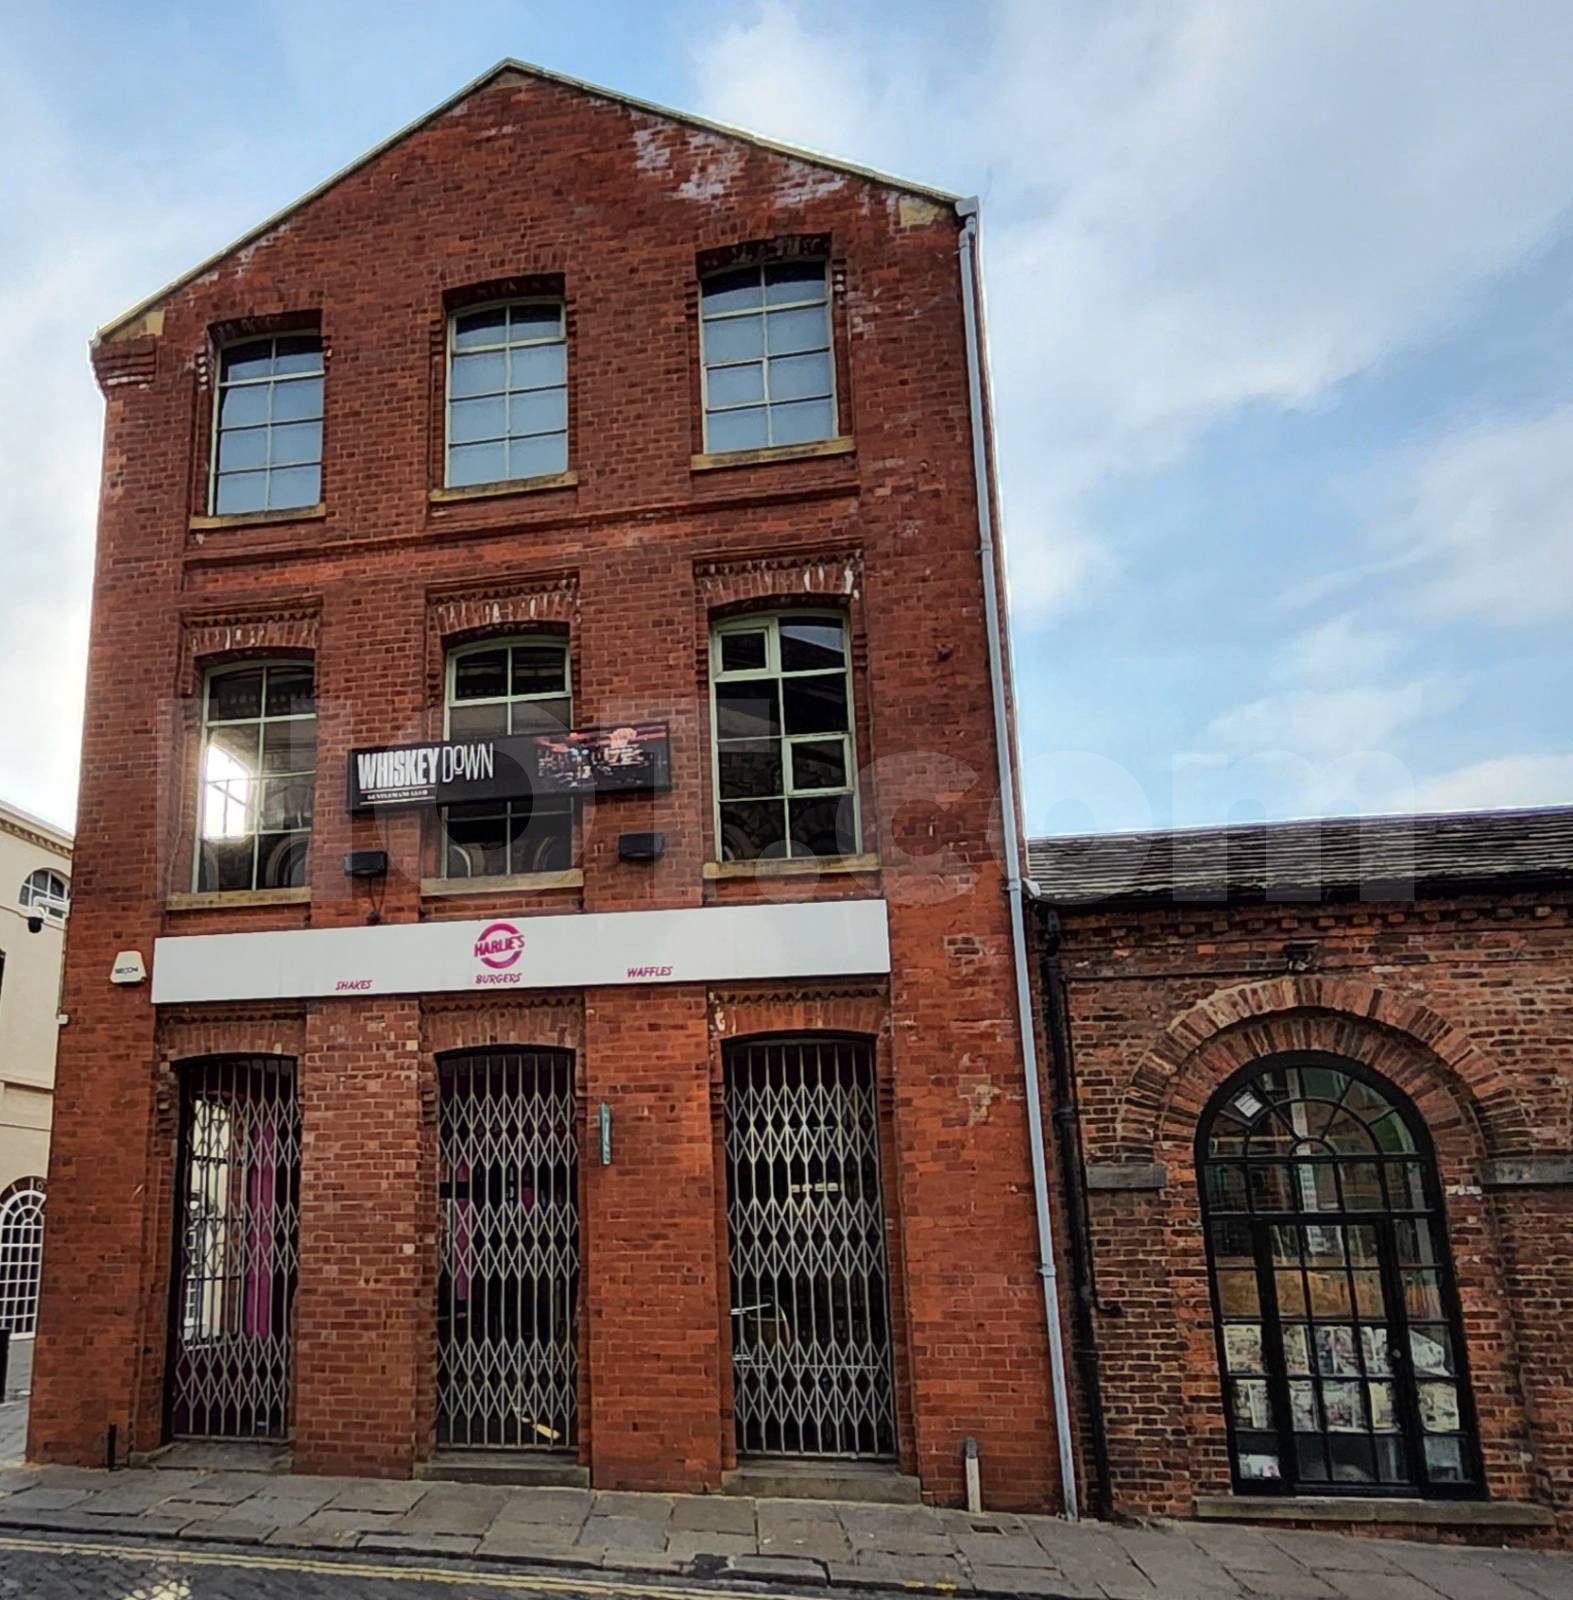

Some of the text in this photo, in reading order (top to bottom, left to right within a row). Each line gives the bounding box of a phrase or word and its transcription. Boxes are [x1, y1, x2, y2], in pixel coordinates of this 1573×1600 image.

[357, 743, 494, 789] WHISKEY DOWN
[474, 935, 525, 957] HARLIE'S
[627, 966, 673, 978] WAFFLES
[475, 973, 523, 985] BURGERS
[335, 980, 372, 991] SHAKES
